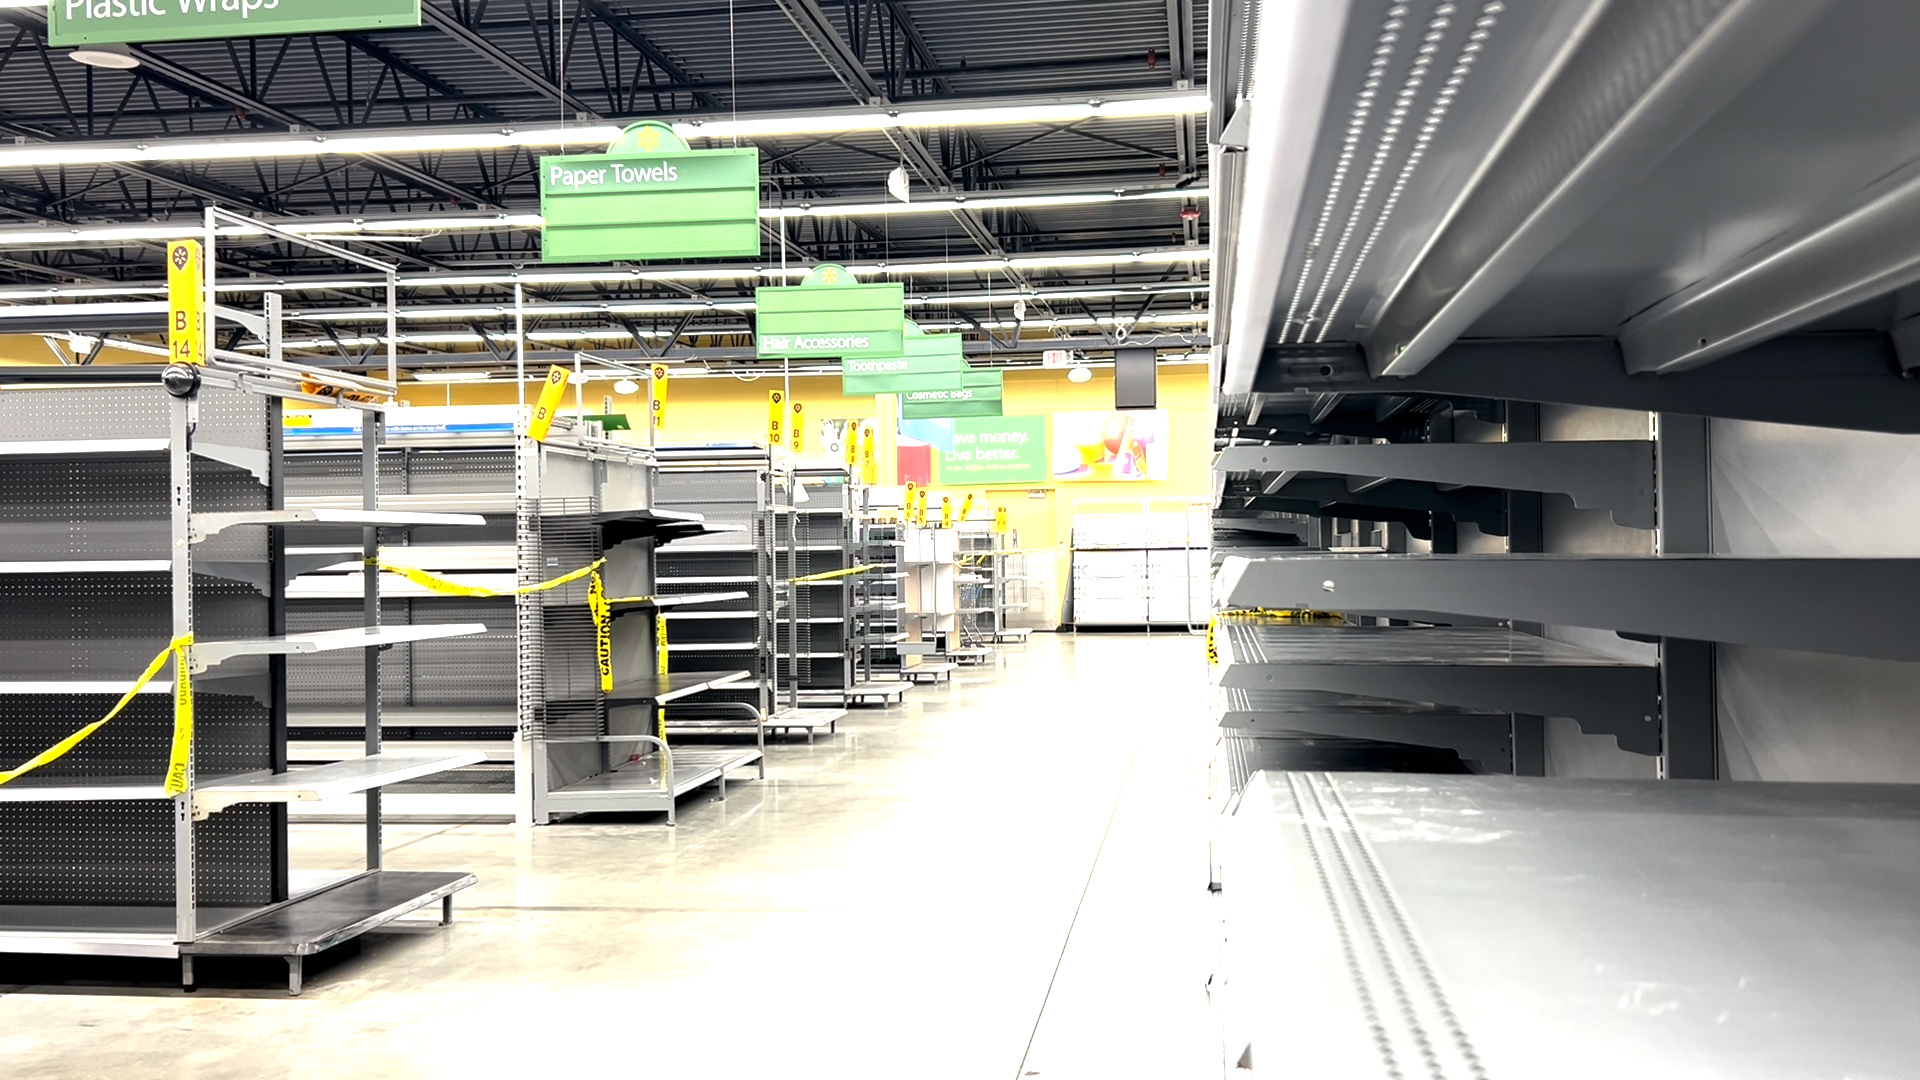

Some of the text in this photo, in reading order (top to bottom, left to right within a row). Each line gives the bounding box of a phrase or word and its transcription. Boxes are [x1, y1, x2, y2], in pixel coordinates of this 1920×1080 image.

[65, 0, 166, 20] Plastic
[550, 161, 678, 190] Paper Towels
[175, 310, 187, 331] B
[172, 338, 191, 359] 14
[763, 334, 870, 350] Hair Accessories
[1047, 352, 1062, 364] EXIT
[846, 359, 909, 373] Toothpaste
[652, 400, 661, 411] B
[536, 406, 547, 420] B
[771, 421, 779, 431] B
[769, 433, 781, 443] 10
[793, 429, 800, 438] B
[979, 431, 1030, 446] money.
[793, 441, 799, 449] 9
[975, 446, 1020, 461] better.
[600, 613, 611, 676] CAUTION
